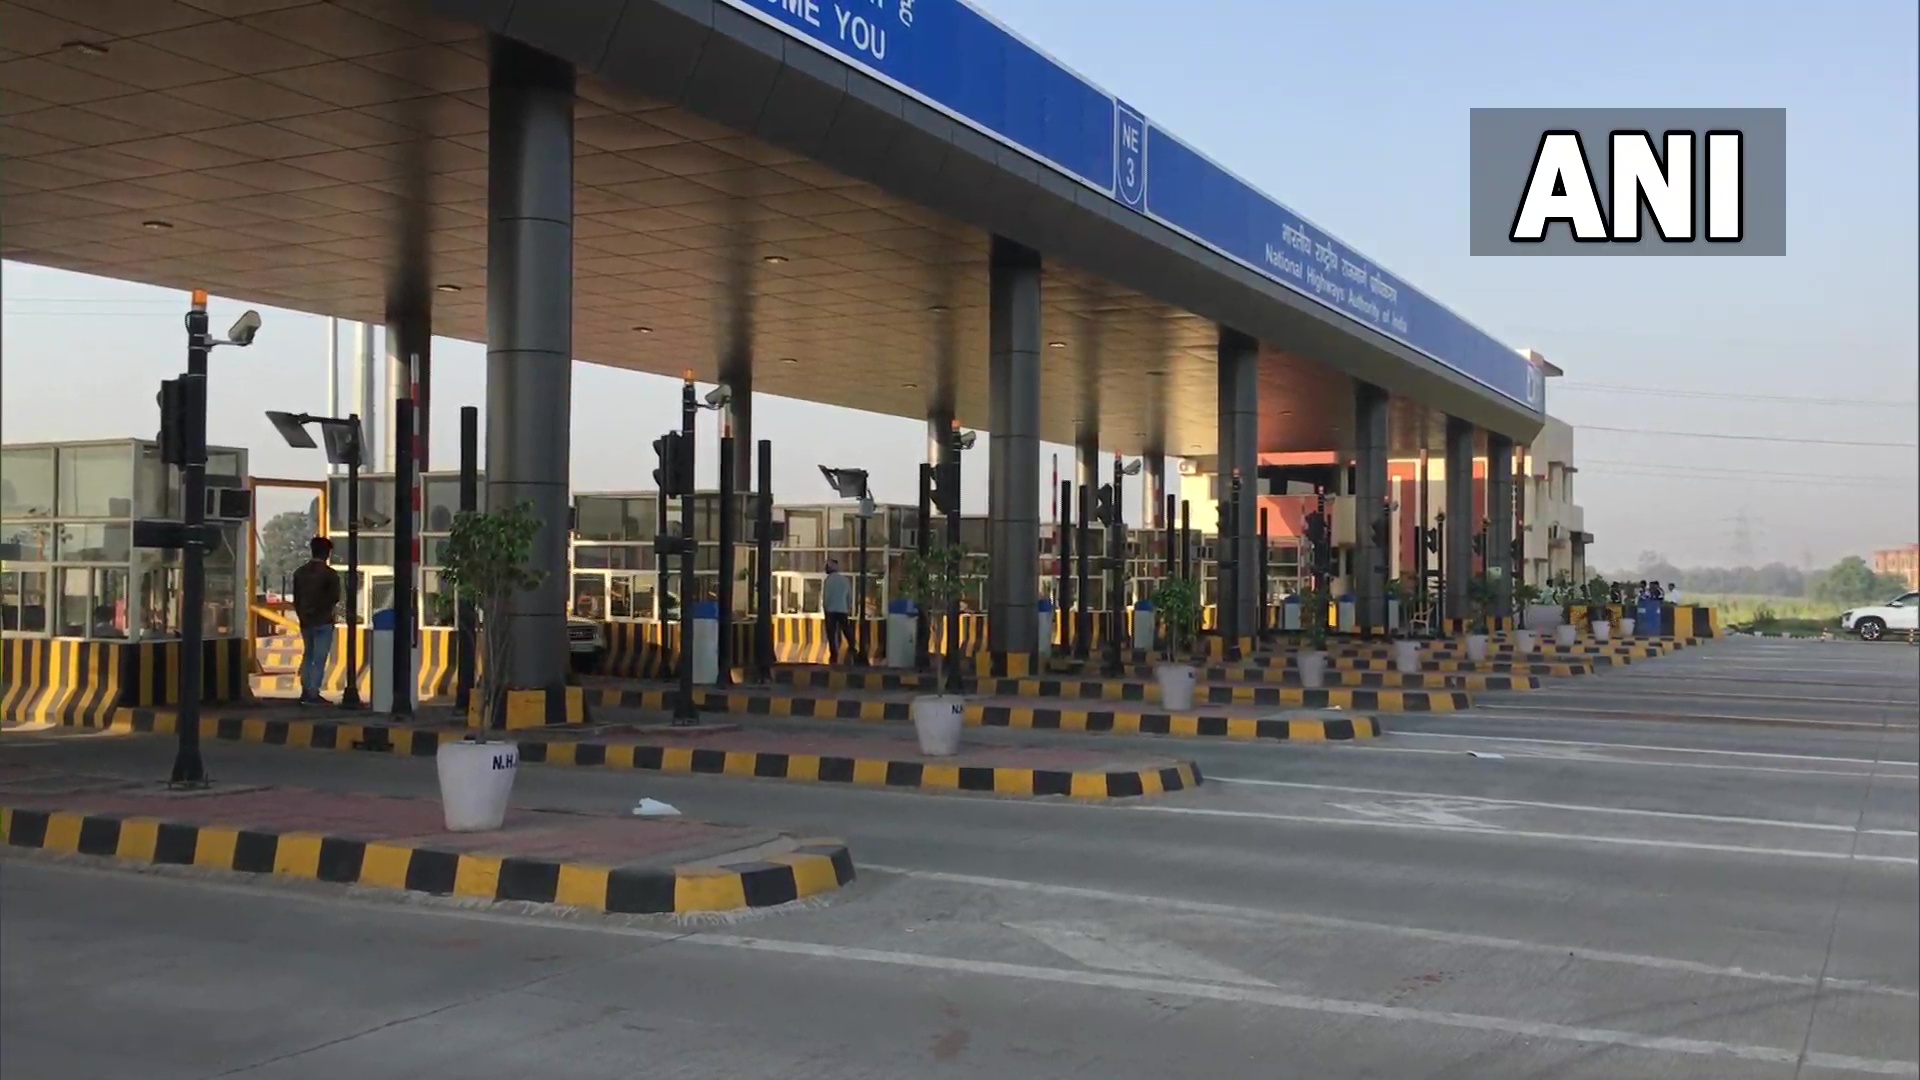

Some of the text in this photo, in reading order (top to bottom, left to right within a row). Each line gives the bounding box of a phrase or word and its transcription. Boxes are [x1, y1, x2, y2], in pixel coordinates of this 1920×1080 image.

[834, 4, 886, 60] YOU
[1122, 122, 1139, 154] NE
[1126, 157, 1134, 188] 3
[1265, 242, 1304, 280] National
[1306, 265, 1345, 303] Highways
